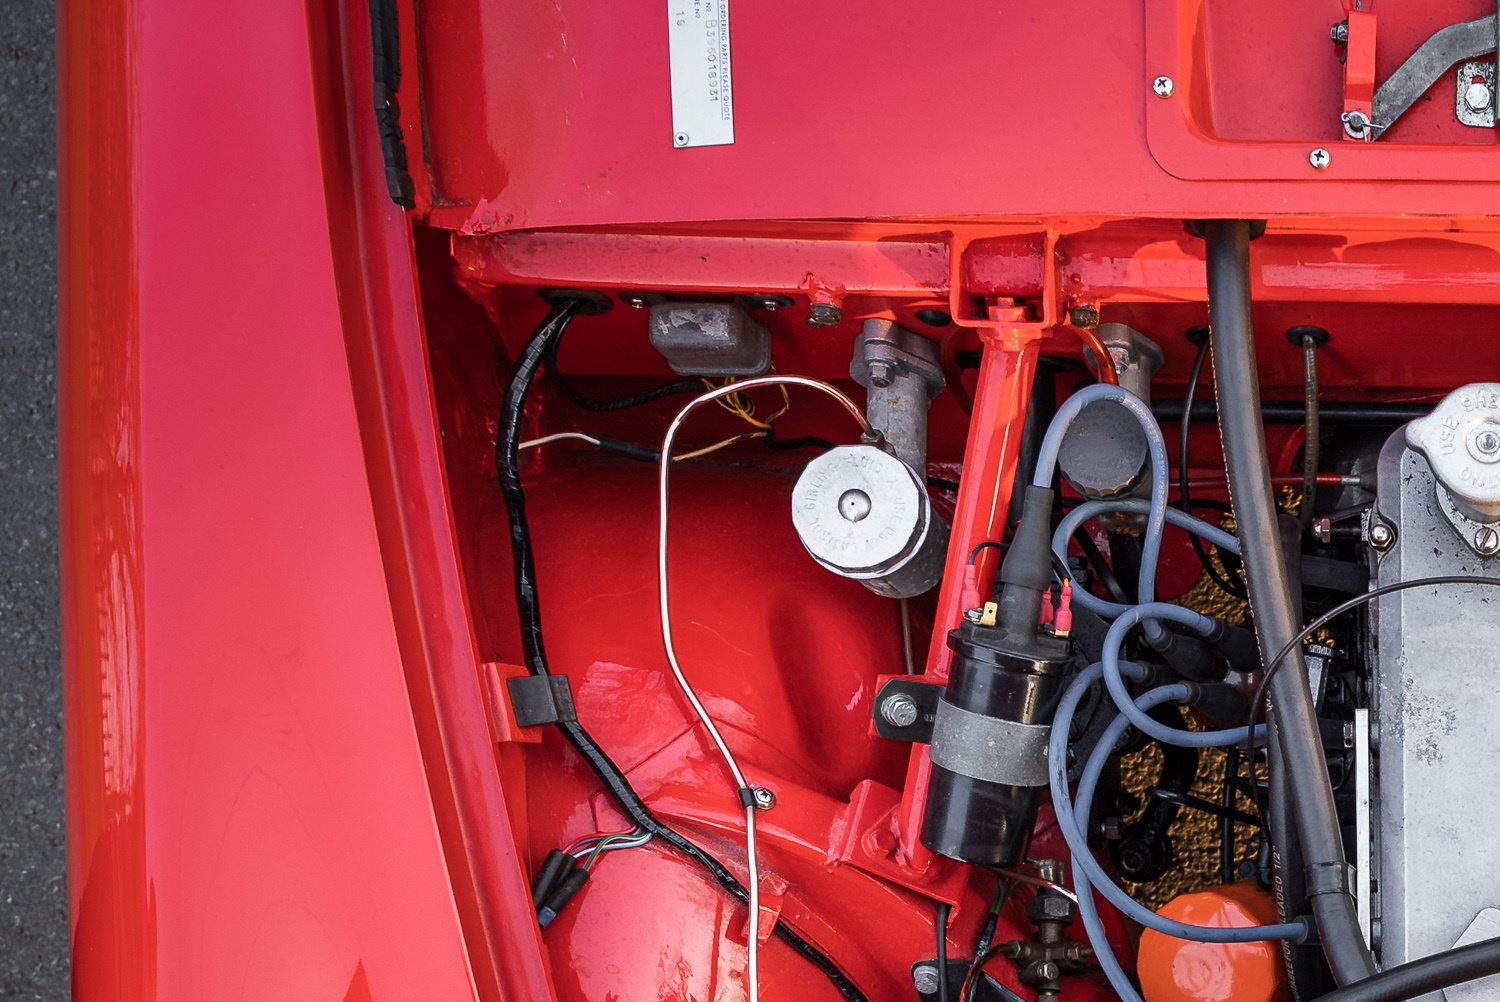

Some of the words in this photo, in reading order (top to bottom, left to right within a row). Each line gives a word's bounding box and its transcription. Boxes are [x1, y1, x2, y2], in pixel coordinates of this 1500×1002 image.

[719, 2, 728, 42] ORDERING
[720, 44, 729, 65] PARTS
[722, 67, 730, 92] PLEASE
[723, 95, 731, 121] QUOTE
[1440, 417, 1459, 455] USE
[804, 463, 839, 511] GIRLING
[1274, 876, 1287, 926] LEADED
[1281, 939, 1293, 961] FOR
